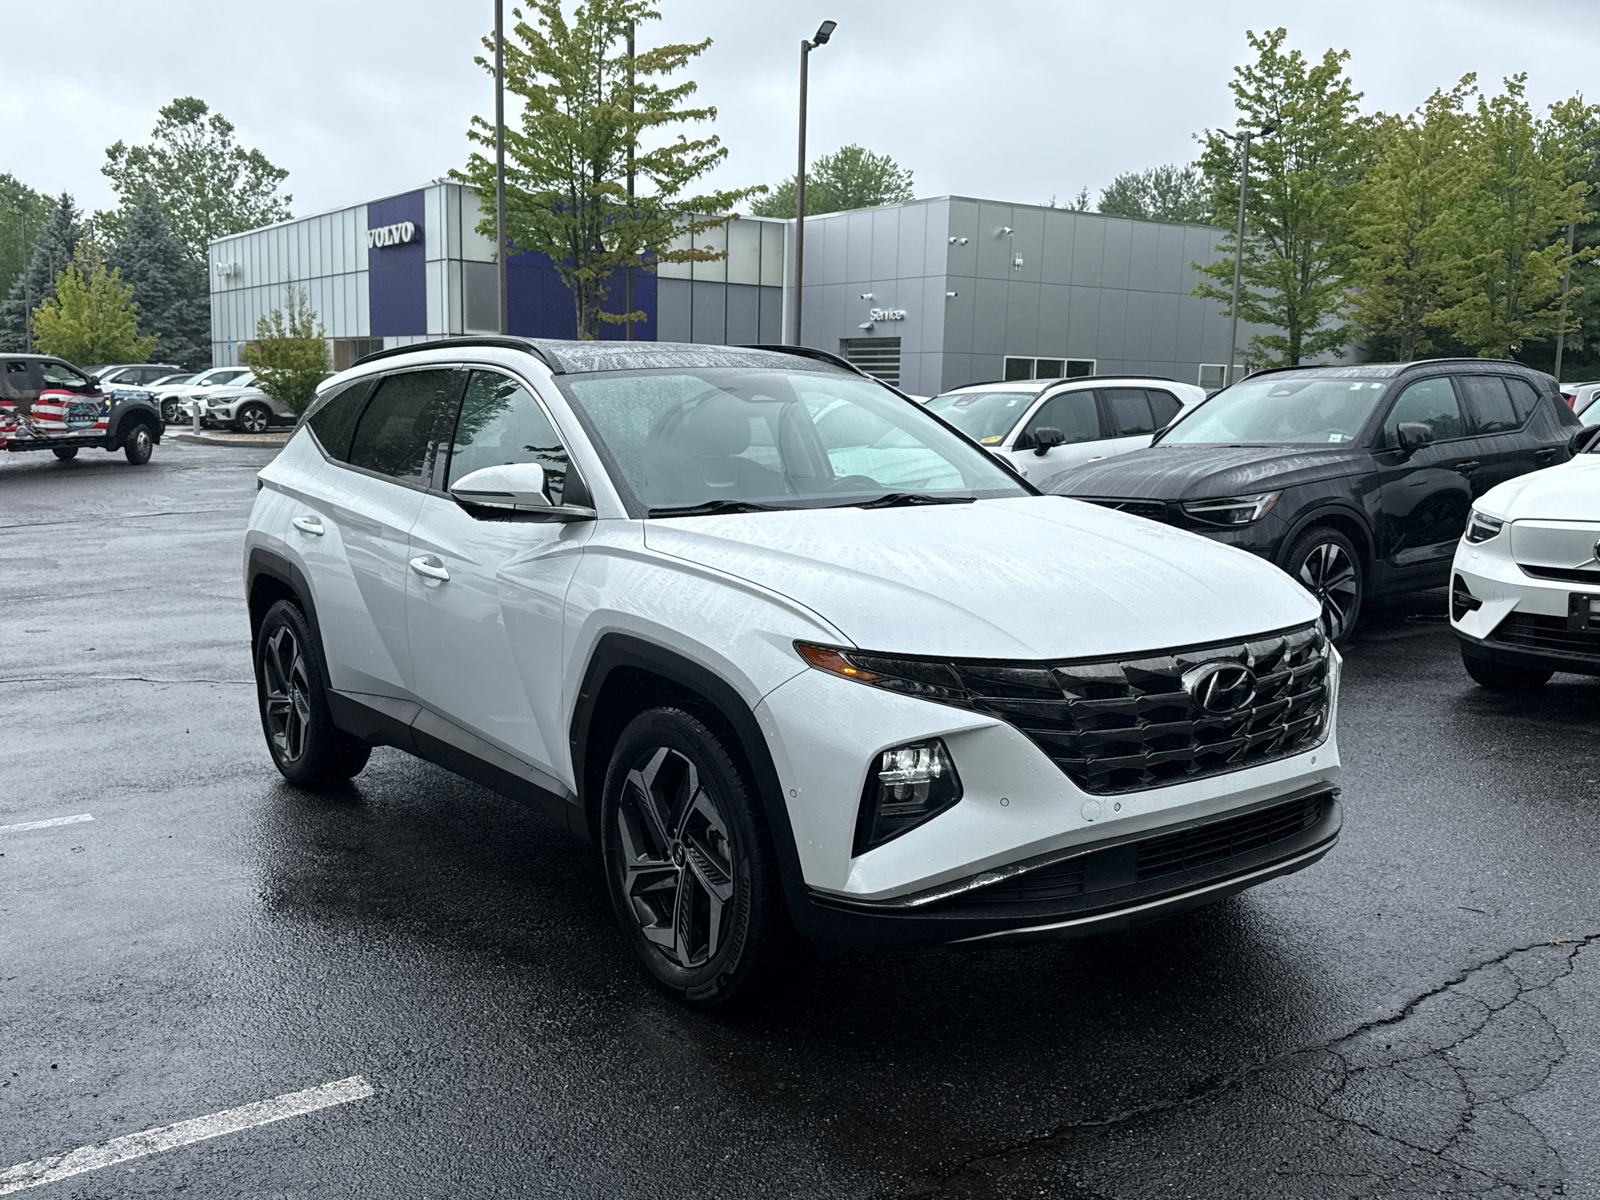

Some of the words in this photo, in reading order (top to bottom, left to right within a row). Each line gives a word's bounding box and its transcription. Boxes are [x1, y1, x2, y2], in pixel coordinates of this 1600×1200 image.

[364, 221, 414, 249] VOLVO
[870, 308, 904, 320] Service
[730, 876, 750, 968] BRIDGESTONE
